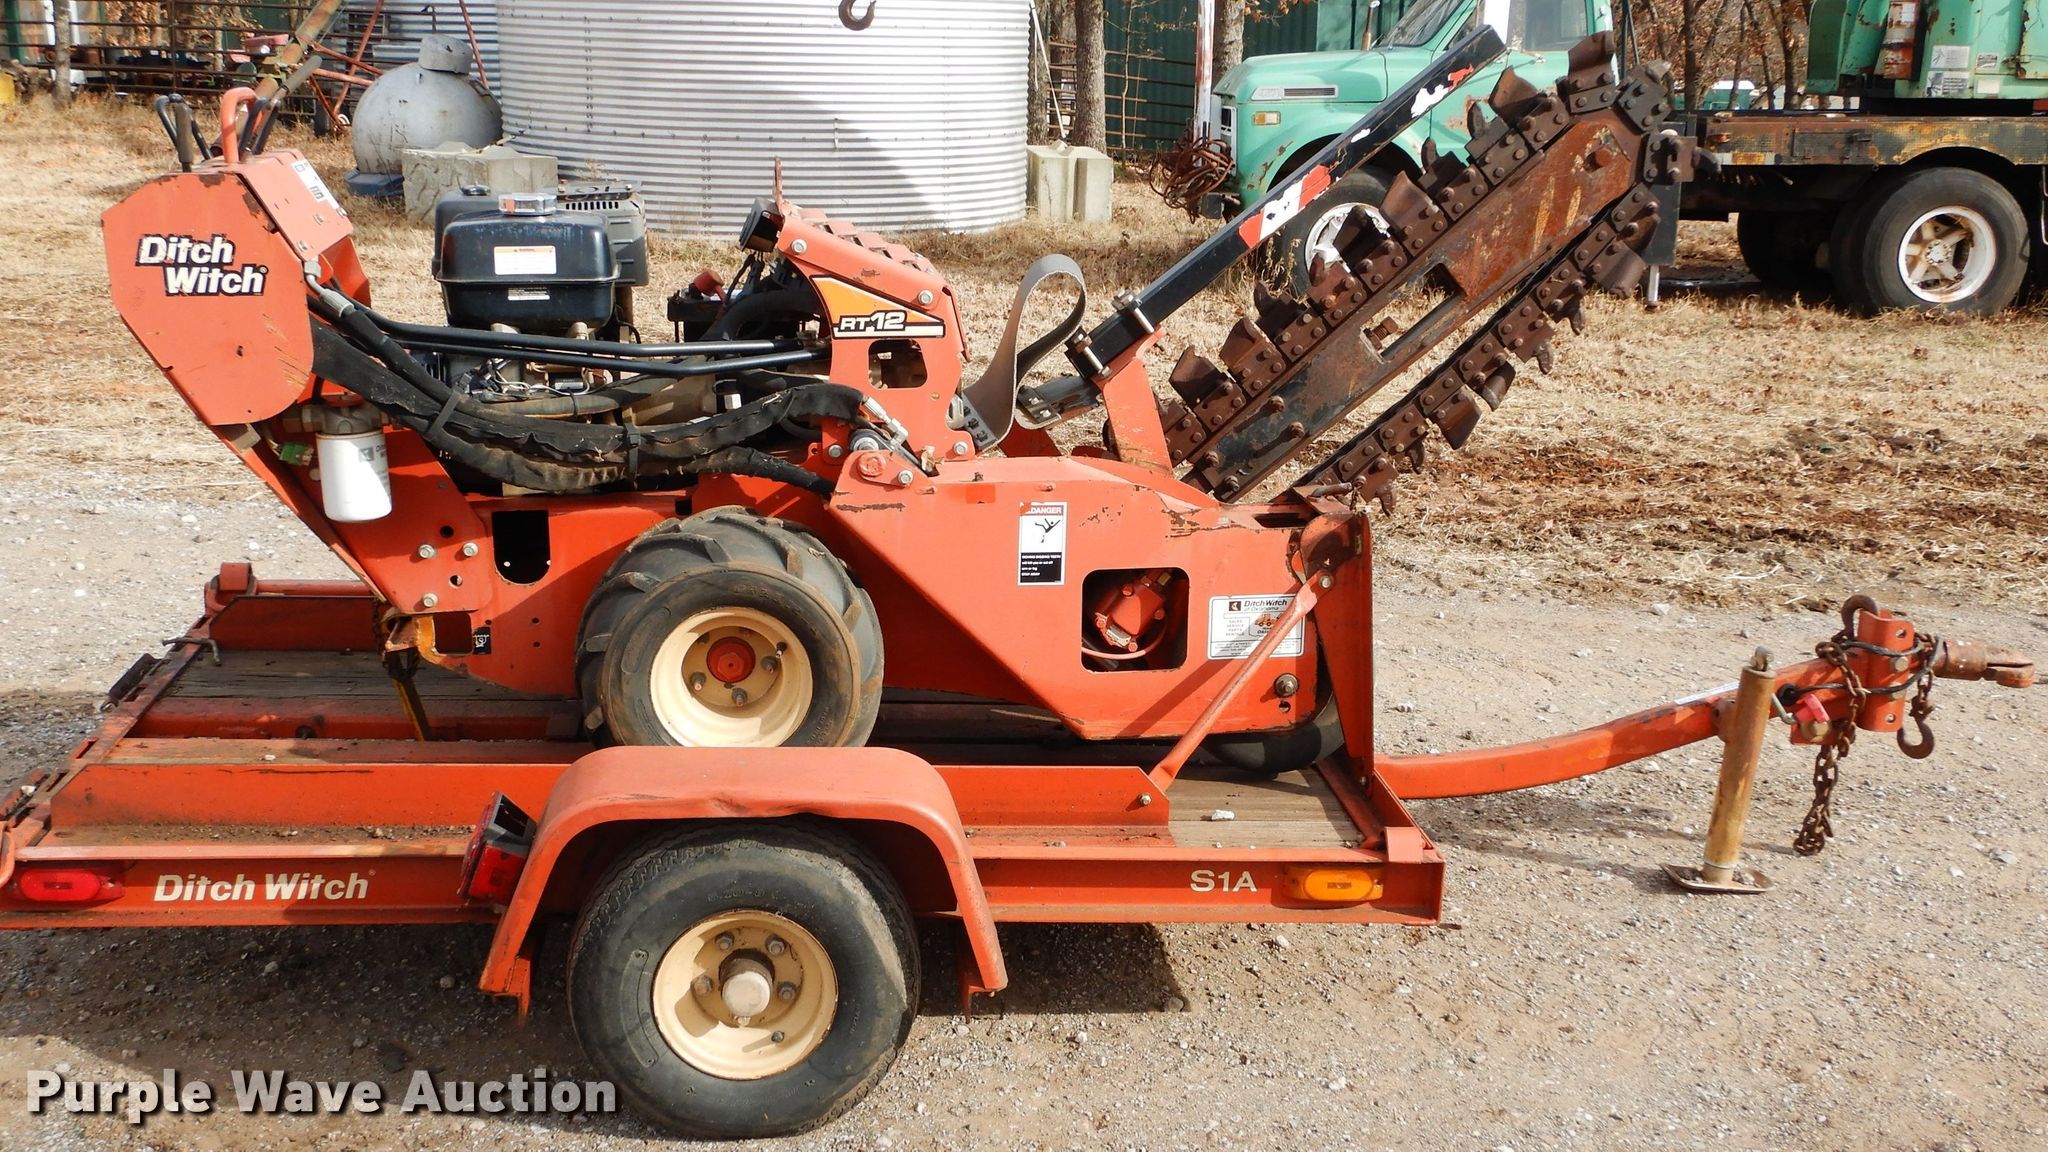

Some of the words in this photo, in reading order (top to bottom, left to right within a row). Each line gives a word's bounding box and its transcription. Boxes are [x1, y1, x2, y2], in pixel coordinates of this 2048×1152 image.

[138, 235, 235, 265] Ditch
[165, 265, 266, 295] Witch
[839, 310, 907, 331] RT12
[1030, 506, 1062, 514] DANGER
[154, 873, 256, 902] Ditch
[264, 872, 369, 900] Witch
[1190, 869, 1258, 893] S1A
